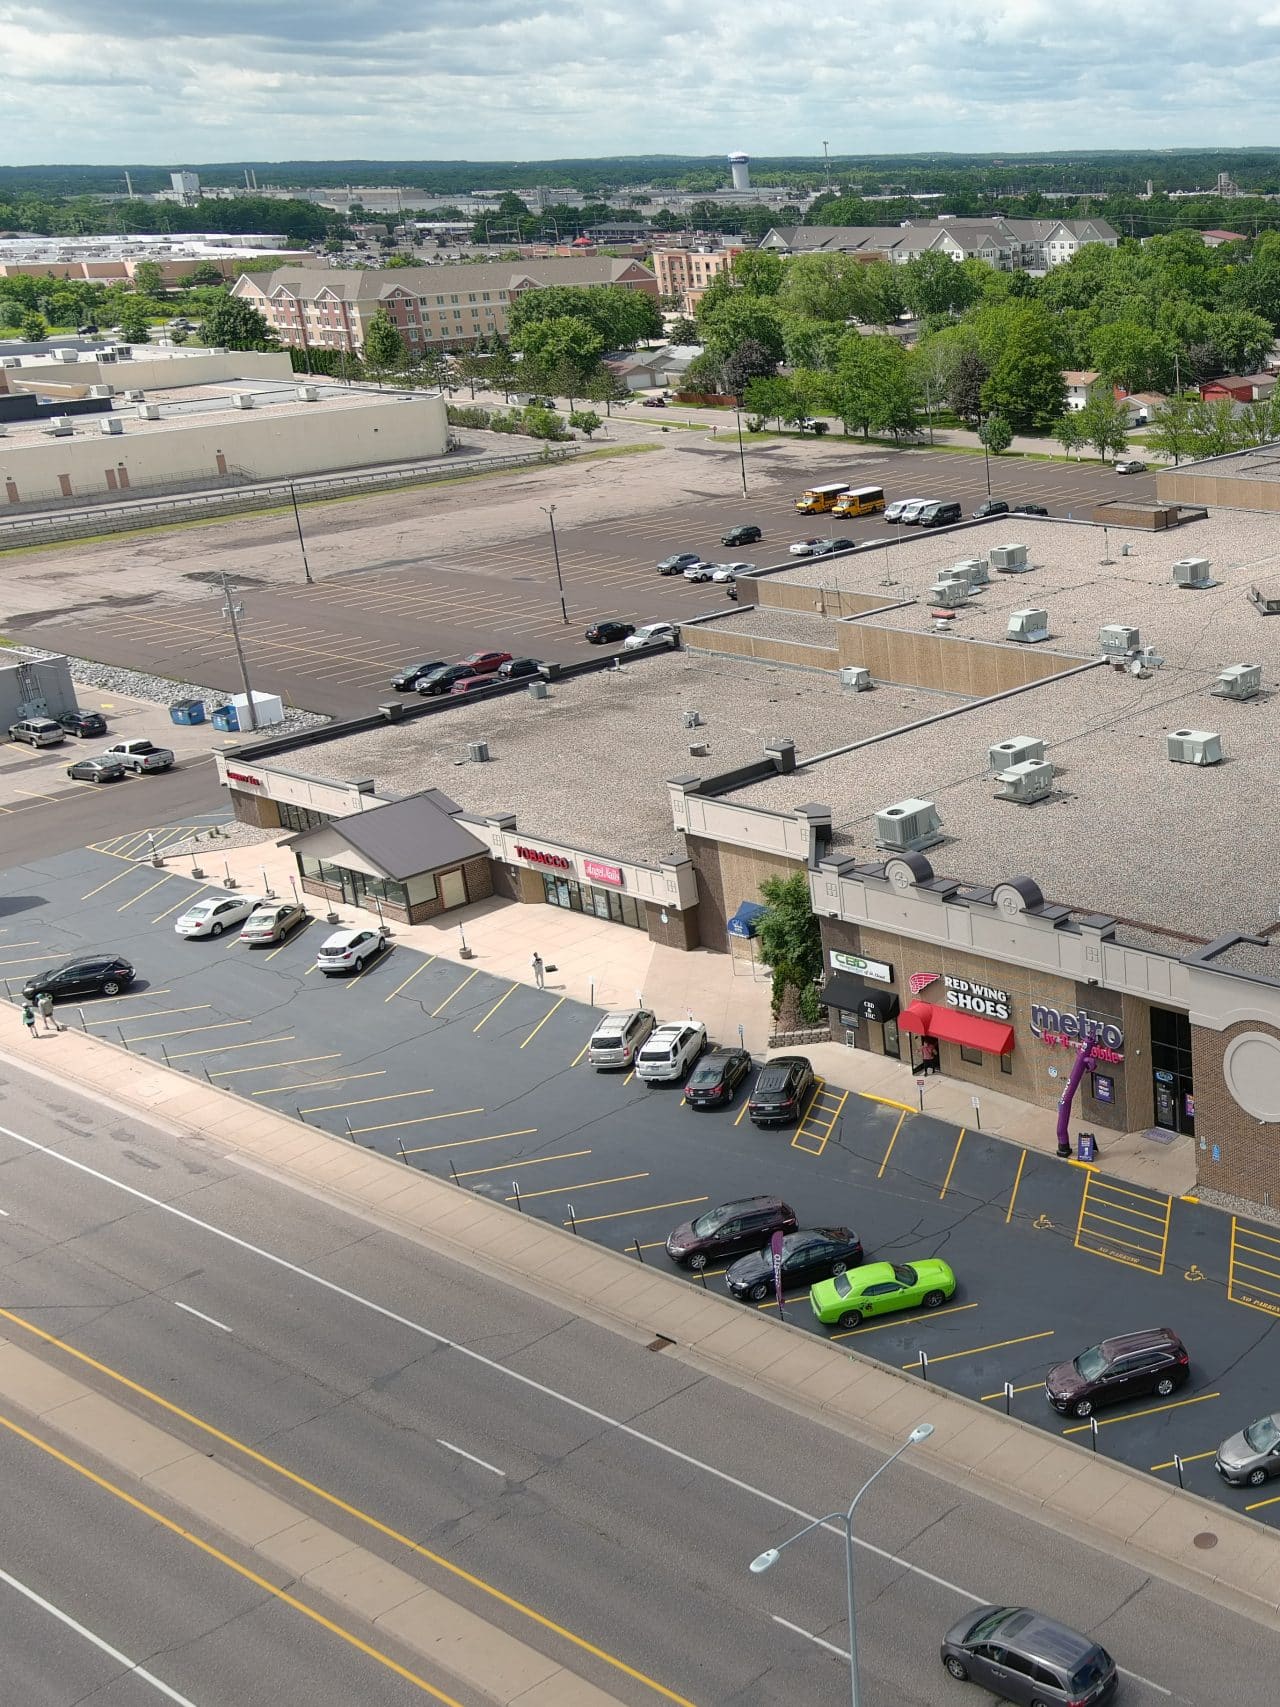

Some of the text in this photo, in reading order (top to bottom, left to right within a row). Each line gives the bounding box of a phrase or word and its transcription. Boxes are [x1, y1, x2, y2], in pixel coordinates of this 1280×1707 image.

[514, 845, 569, 870] TOBACCO
[835, 953, 868, 970] CBD
[944, 976, 1007, 1002] RED WING
[864, 1001, 875, 1009] CBD
[864, 1012, 876, 1020] THC
[946, 990, 1010, 1020] SHOES
[1031, 1004, 1124, 1050] metro
